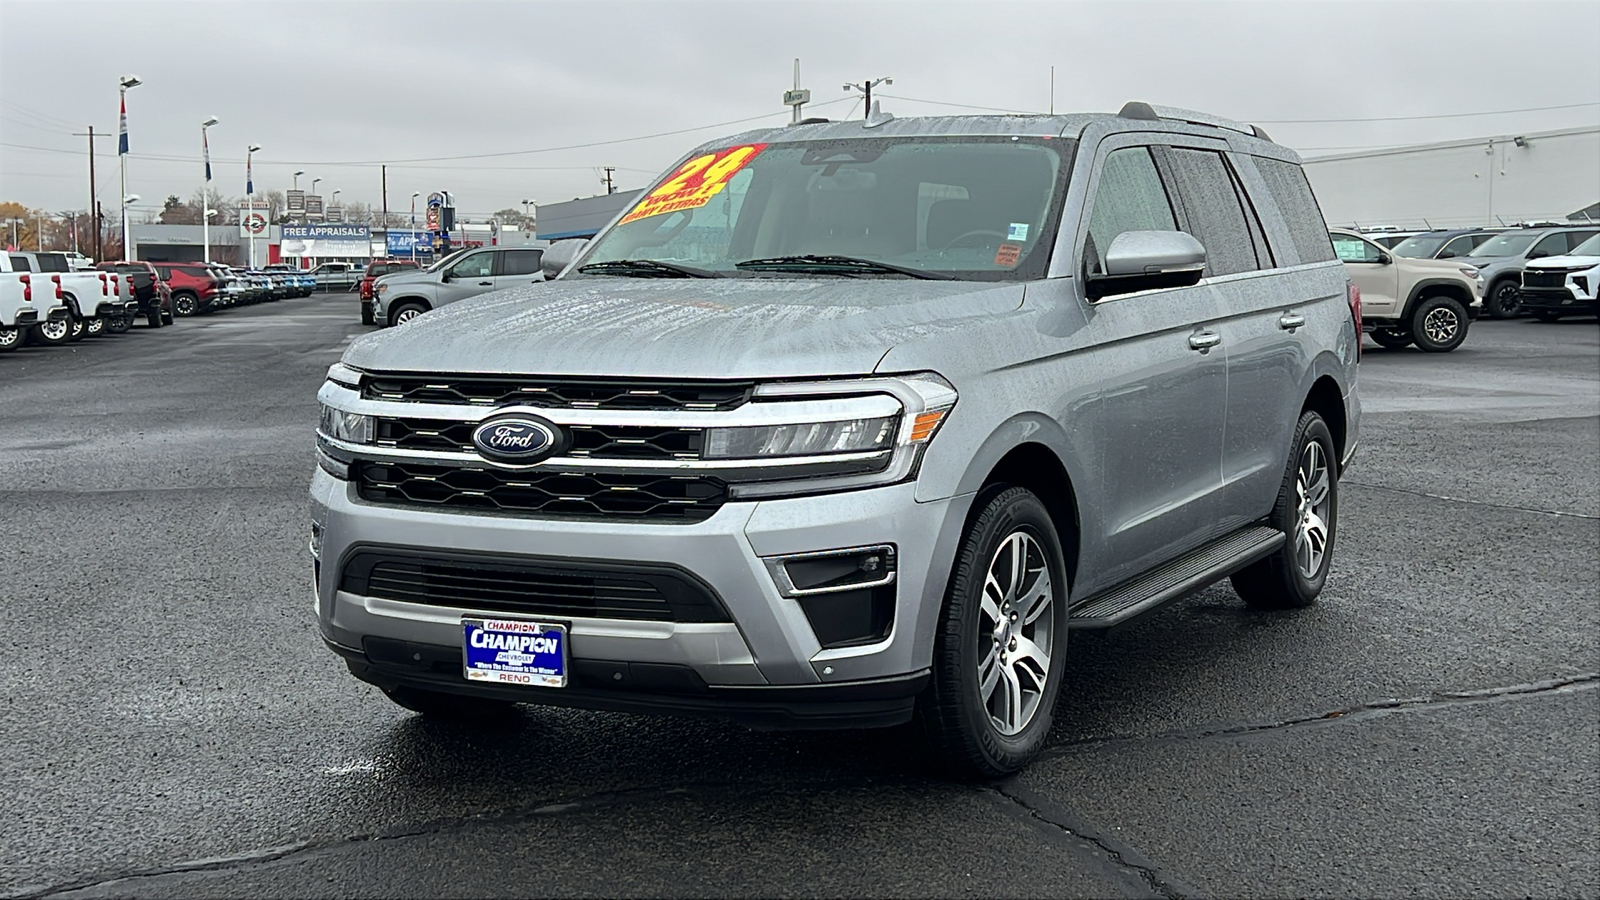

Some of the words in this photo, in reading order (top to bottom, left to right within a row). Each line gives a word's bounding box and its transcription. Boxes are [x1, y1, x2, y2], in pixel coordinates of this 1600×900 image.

[650, 147, 754, 197] 24
[621, 206, 659, 223] MANY
[657, 196, 709, 213] EXTRAS
[284, 227, 307, 236] FREE
[309, 227, 368, 236] APPRAISALS!
[490, 426, 534, 448] Ford
[487, 622, 536, 633] CHAMPION
[470, 629, 558, 654] CHAMPION
[498, 653, 532, 662] CHEVROLET
[499, 673, 531, 683] RENO
